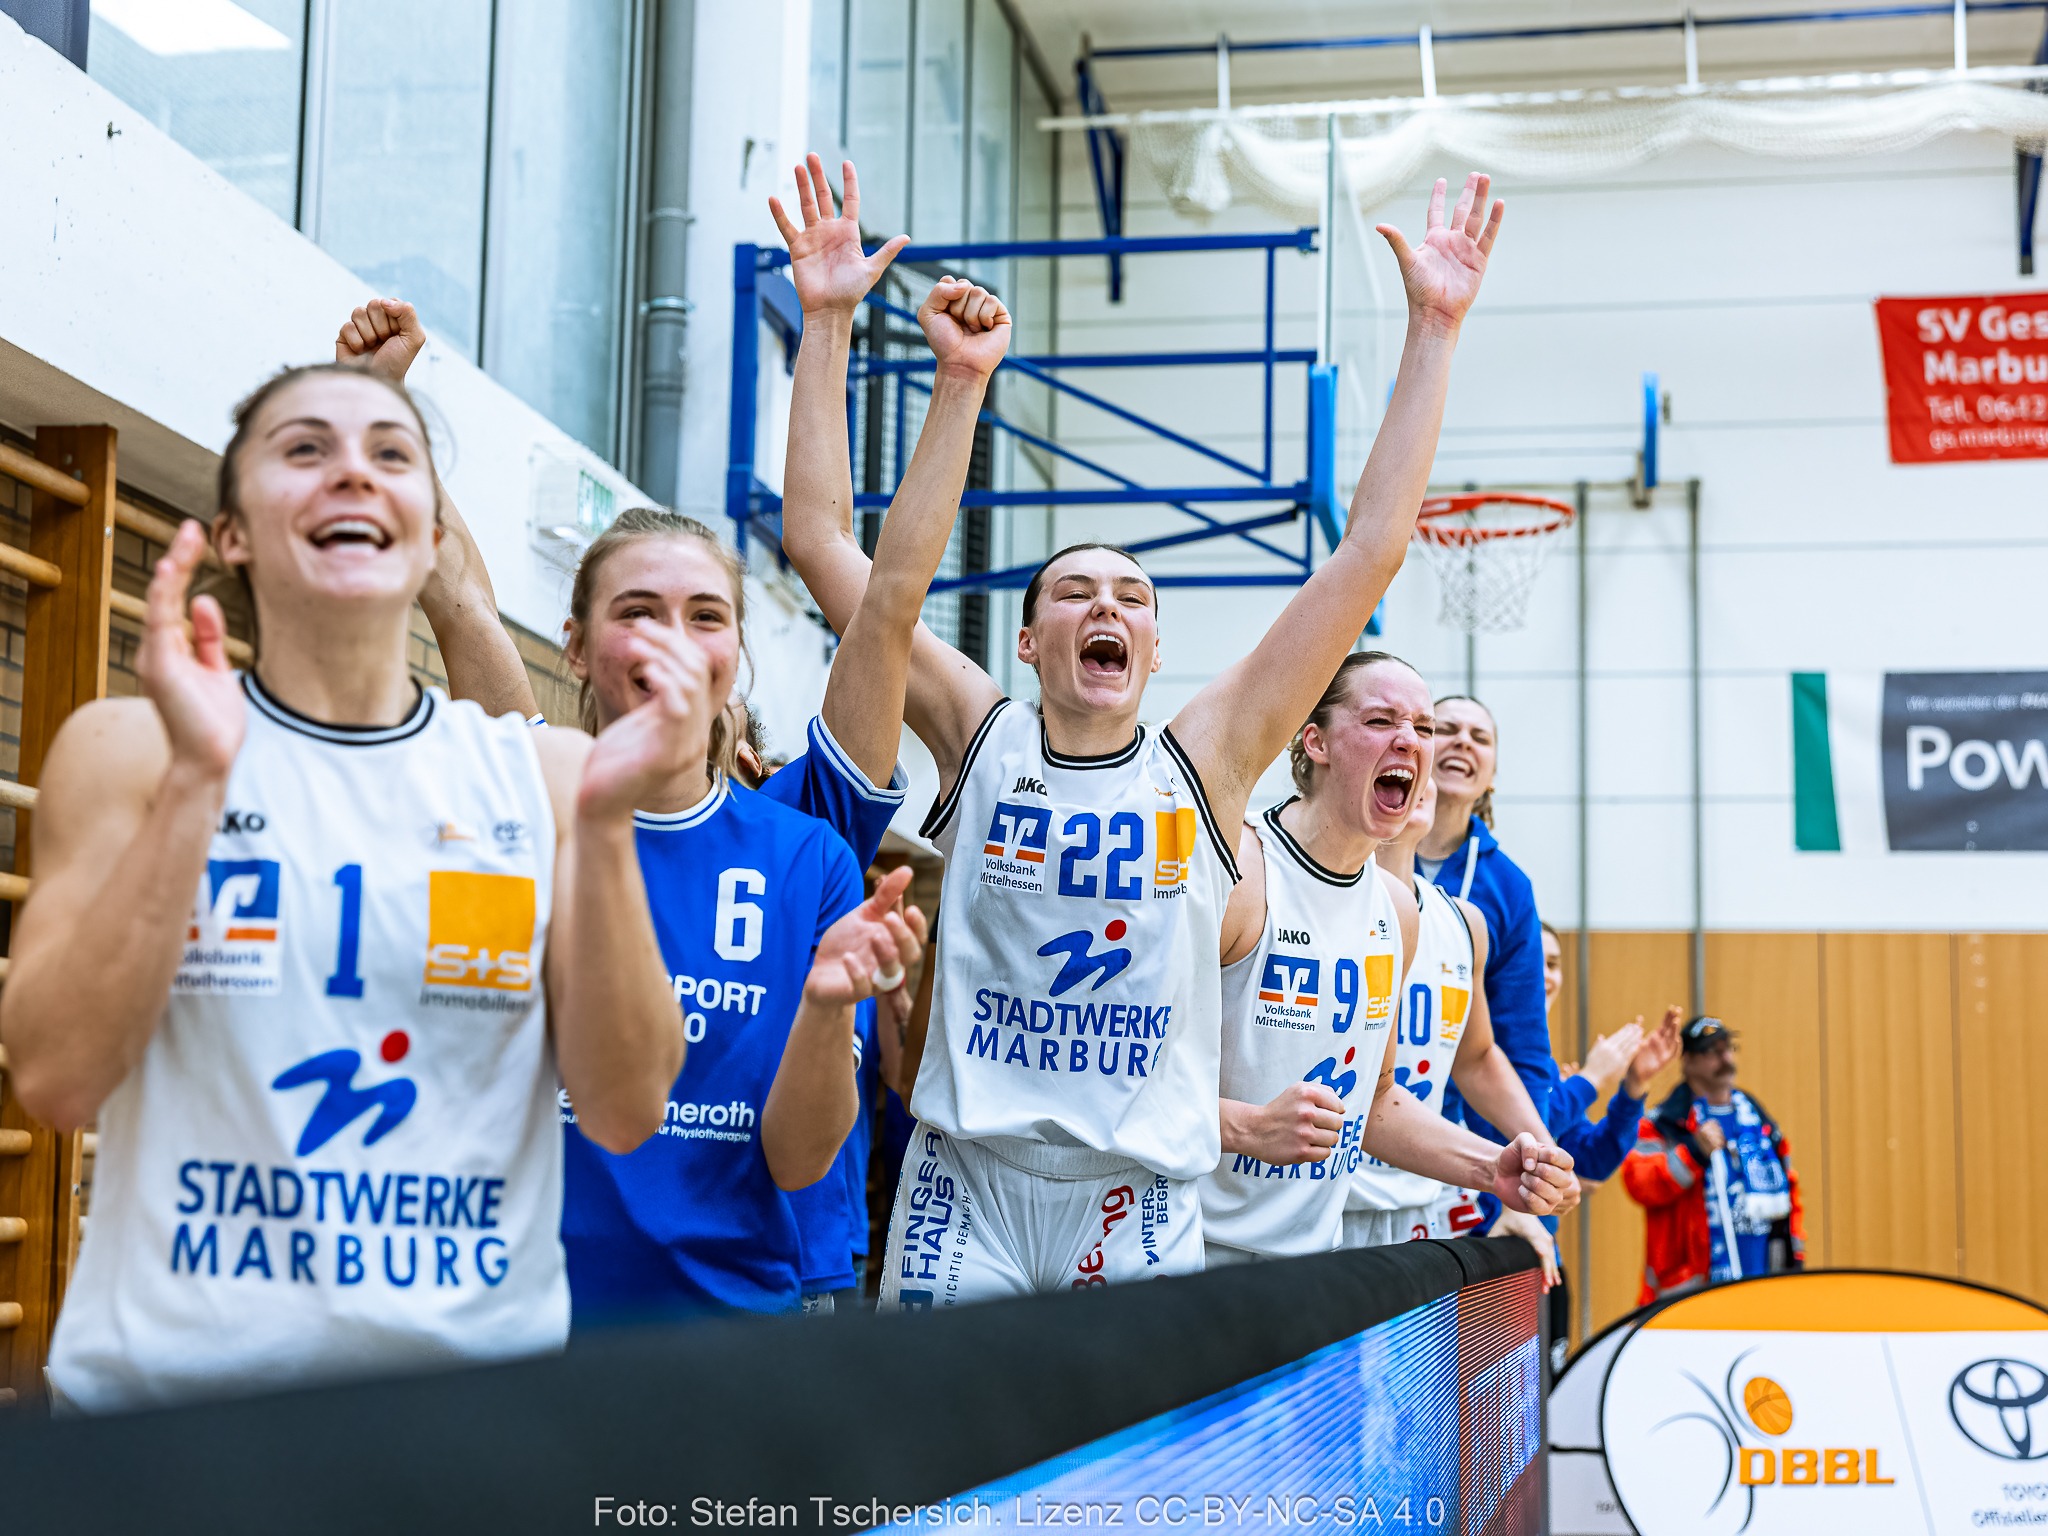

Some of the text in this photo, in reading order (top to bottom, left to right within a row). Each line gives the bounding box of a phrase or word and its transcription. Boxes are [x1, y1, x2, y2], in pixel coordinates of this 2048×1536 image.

[1916, 305, 2048, 343] SV Ges
[1923, 348, 2048, 385] Marbu
[1925, 395, 1974, 424] Tel.
[1906, 725, 2048, 791] Pow
[1013, 777, 1048, 796] JAKO
[222, 811, 266, 834] KO
[985, 858, 1036, 876] Volksbank
[1058, 812, 1143, 900] 22
[980, 872, 1042, 892] Mittelhessen
[325, 863, 365, 998] 1
[714, 867, 767, 962] 6
[1277, 928, 1311, 946] JAKO
[667, 974, 767, 1016] PORT
[973, 988, 1172, 1039] STADTWERKE
[1264, 1003, 1312, 1019] Volksbank
[1332, 958, 1359, 1033] 9
[1255, 1015, 1316, 1032] Mittelhessen
[671, 1125, 752, 1143] Physiotherapie
[1232, 1146, 1360, 1180] MARBUG
[176, 1160, 506, 1228] STADTWERKE
[901, 1131, 943, 1279] FINGER
[917, 1174, 955, 1280] HAUS
[170, 1223, 510, 1288] MARBURG
[944, 1251, 964, 1307] RICHTIG
[1738, 1446, 1895, 1486] DBBL
